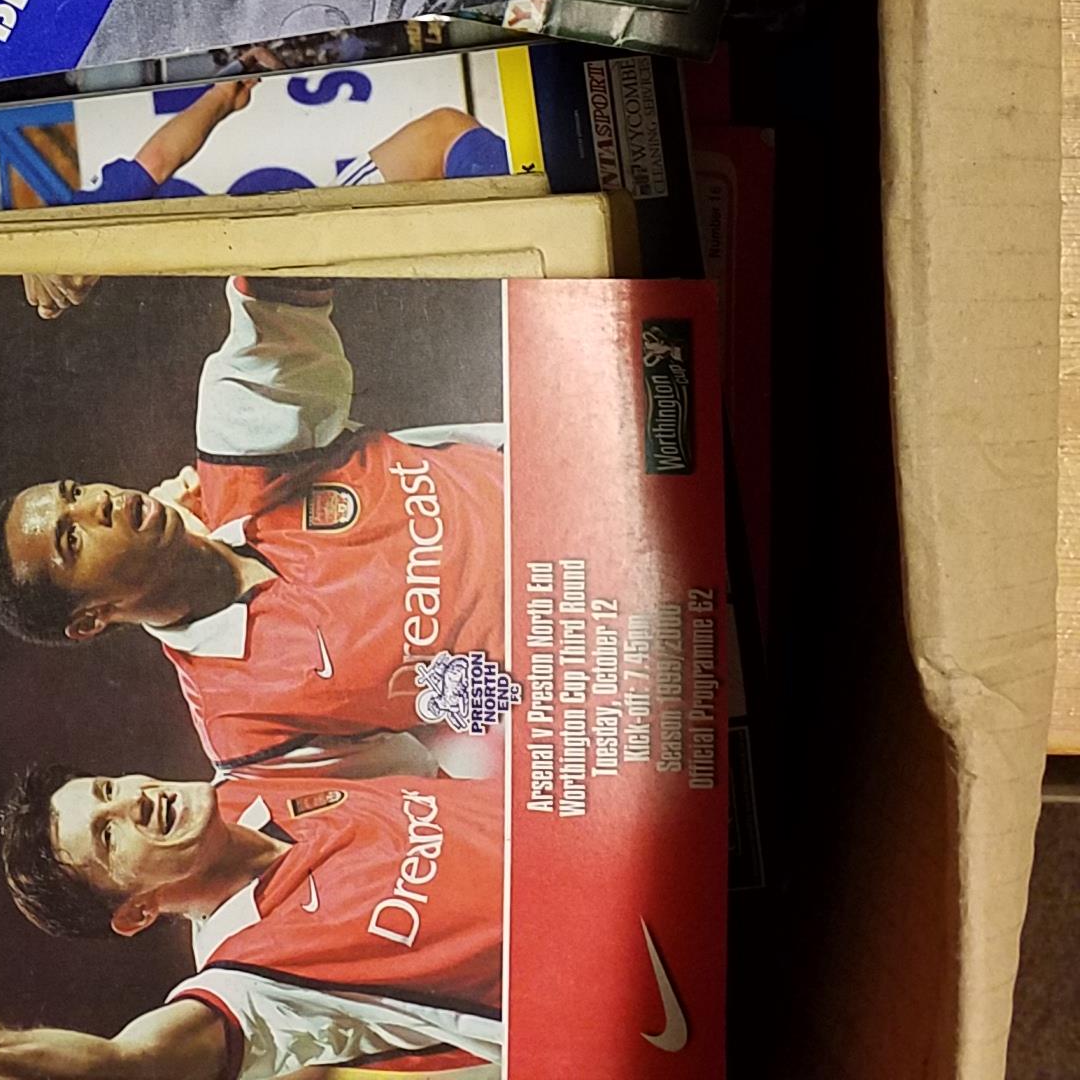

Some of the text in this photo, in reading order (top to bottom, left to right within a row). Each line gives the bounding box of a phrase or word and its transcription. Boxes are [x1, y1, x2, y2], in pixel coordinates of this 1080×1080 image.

[621, 58, 647, 163] WYCOMBE
[638, 56, 655, 117] SERVICES
[651, 374, 687, 471] Worthington
[388, 459, 444, 700] Dreamcast
[470, 653, 483, 733] PRESTON
[484, 664, 496, 722] NORTH
[497, 676, 509, 711] END
[510, 685, 520, 702] FC
[526, 562, 554, 812] Arsenal v Preston North End
[559, 560, 590, 817] Worthington Cup Third Round
[591, 599, 622, 777] Tuesday, October 12
[623, 614, 654, 762] Kick-off: 7.45pm
[656, 605, 684, 772] Season 1999/2000
[688, 588, 719, 789] Official Programme £2
